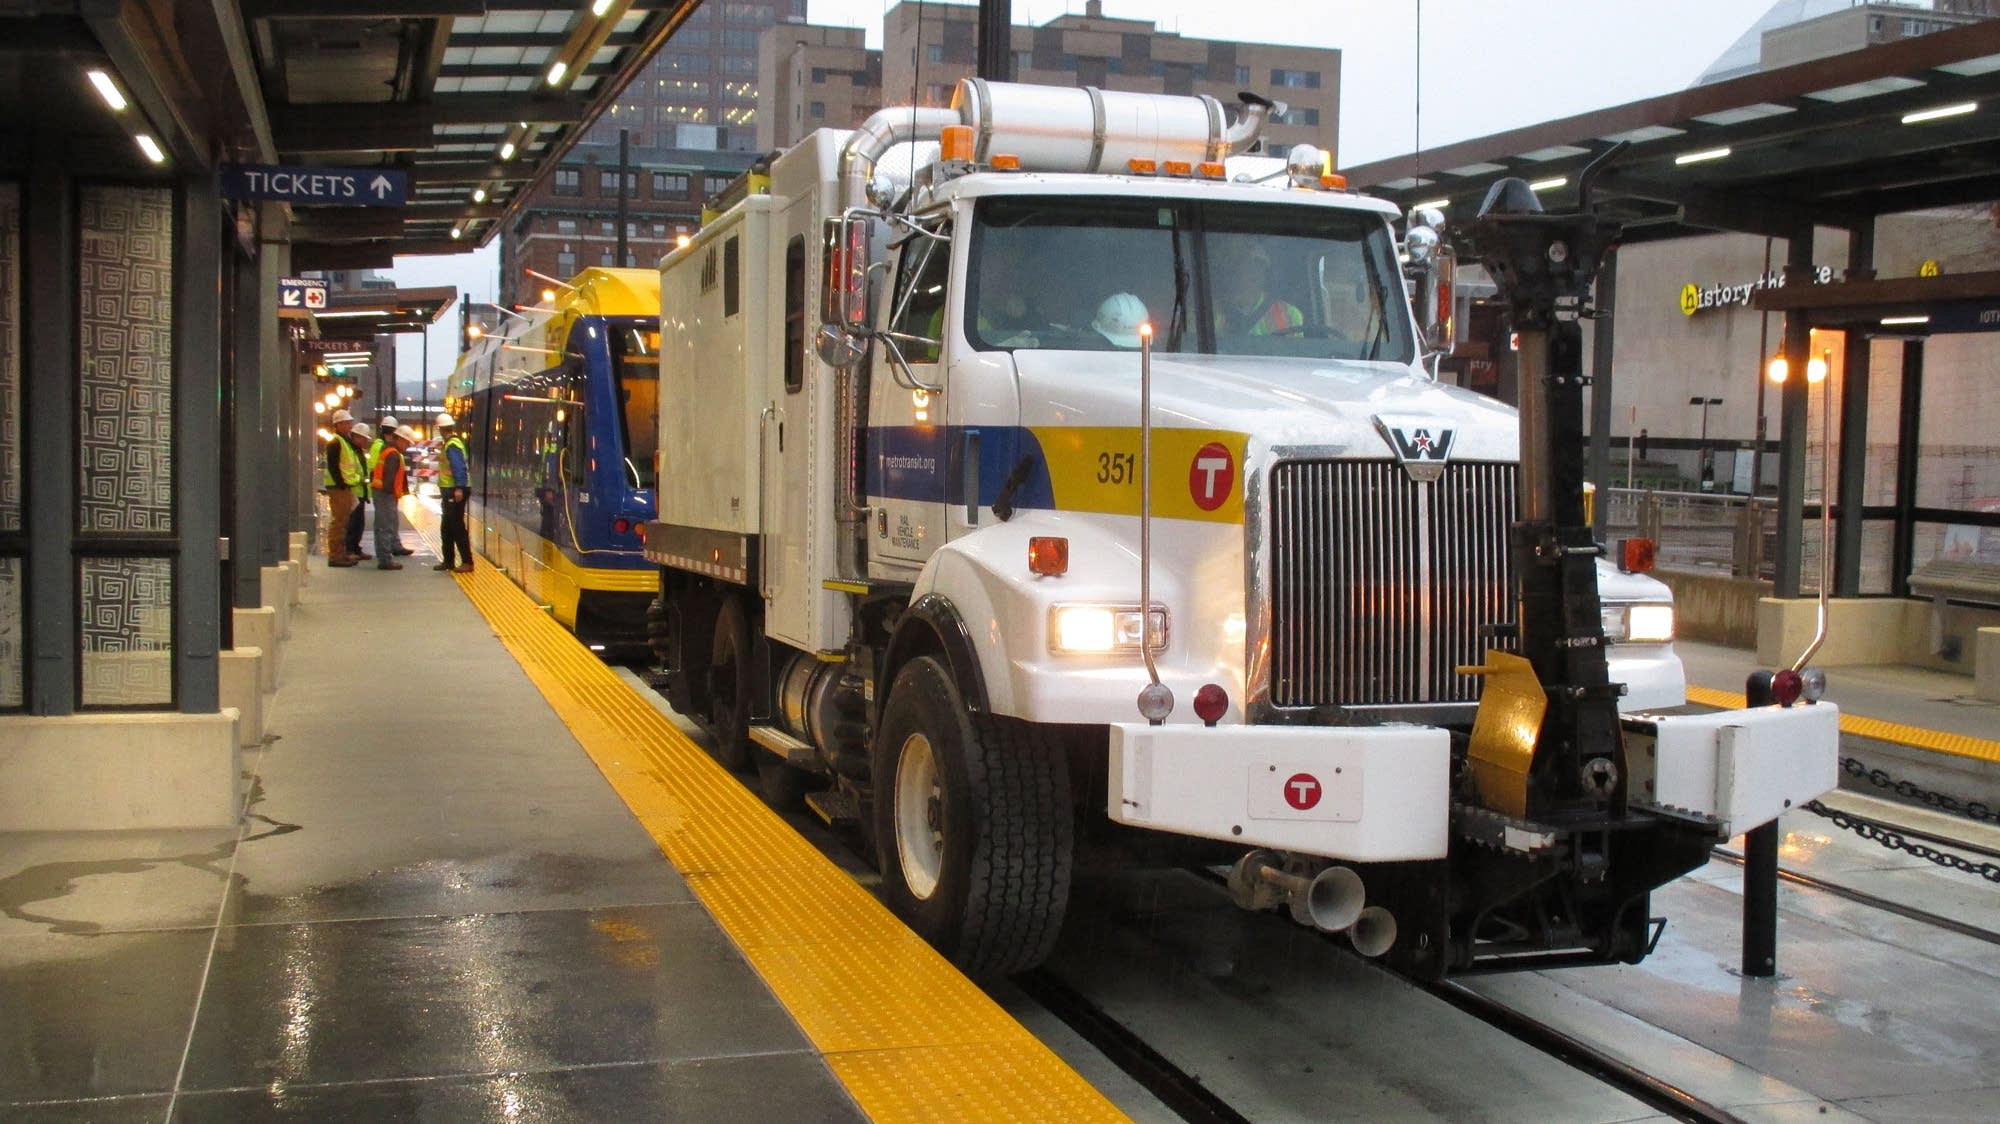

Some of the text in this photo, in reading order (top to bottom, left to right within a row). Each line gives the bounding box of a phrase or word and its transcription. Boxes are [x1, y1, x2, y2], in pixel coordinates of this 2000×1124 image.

[244, 171, 356, 197] TICKETS
[281, 278, 328, 287] EMERGENCY
[1682, 281, 1755, 313] history
[308, 340, 349, 351] TICKETS
[886, 453, 936, 474] metrotransit.org
[1096, 452, 1135, 485] 351
[1197, 457, 1228, 499] T
[900, 515, 909, 526] RAIL
[897, 526, 914, 538] VEHICLE
[891, 537, 920, 551] MAINTENANCE
[1290, 781, 1316, 804] T
